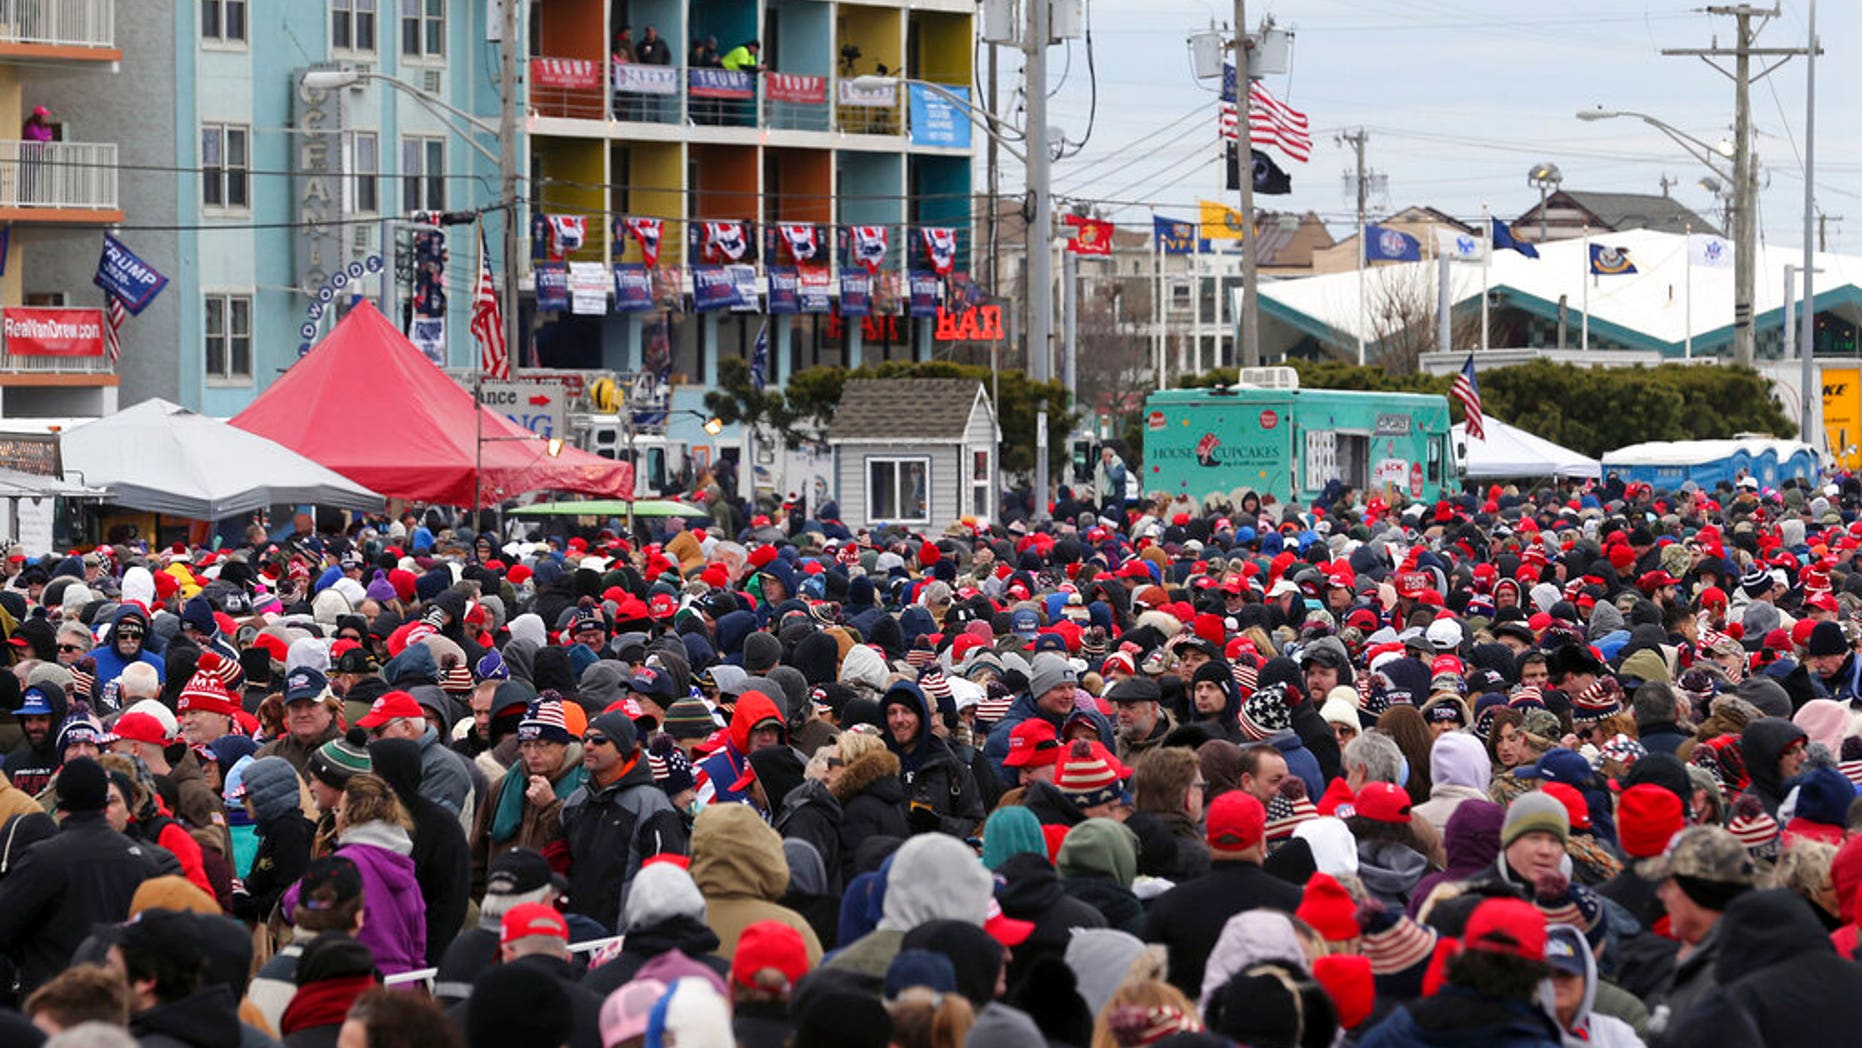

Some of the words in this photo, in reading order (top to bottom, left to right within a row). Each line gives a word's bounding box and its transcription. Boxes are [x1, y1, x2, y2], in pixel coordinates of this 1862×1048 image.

[542, 58, 592, 76] TRUMP
[697, 69, 748, 88] TRUMP
[775, 73, 819, 91] TRUMP
[105, 240, 157, 284] TRUMP
[935, 305, 1004, 340] BAR
[1153, 446, 1194, 459] HOUSE
[1211, 446, 1280, 460] CUPCAKES
